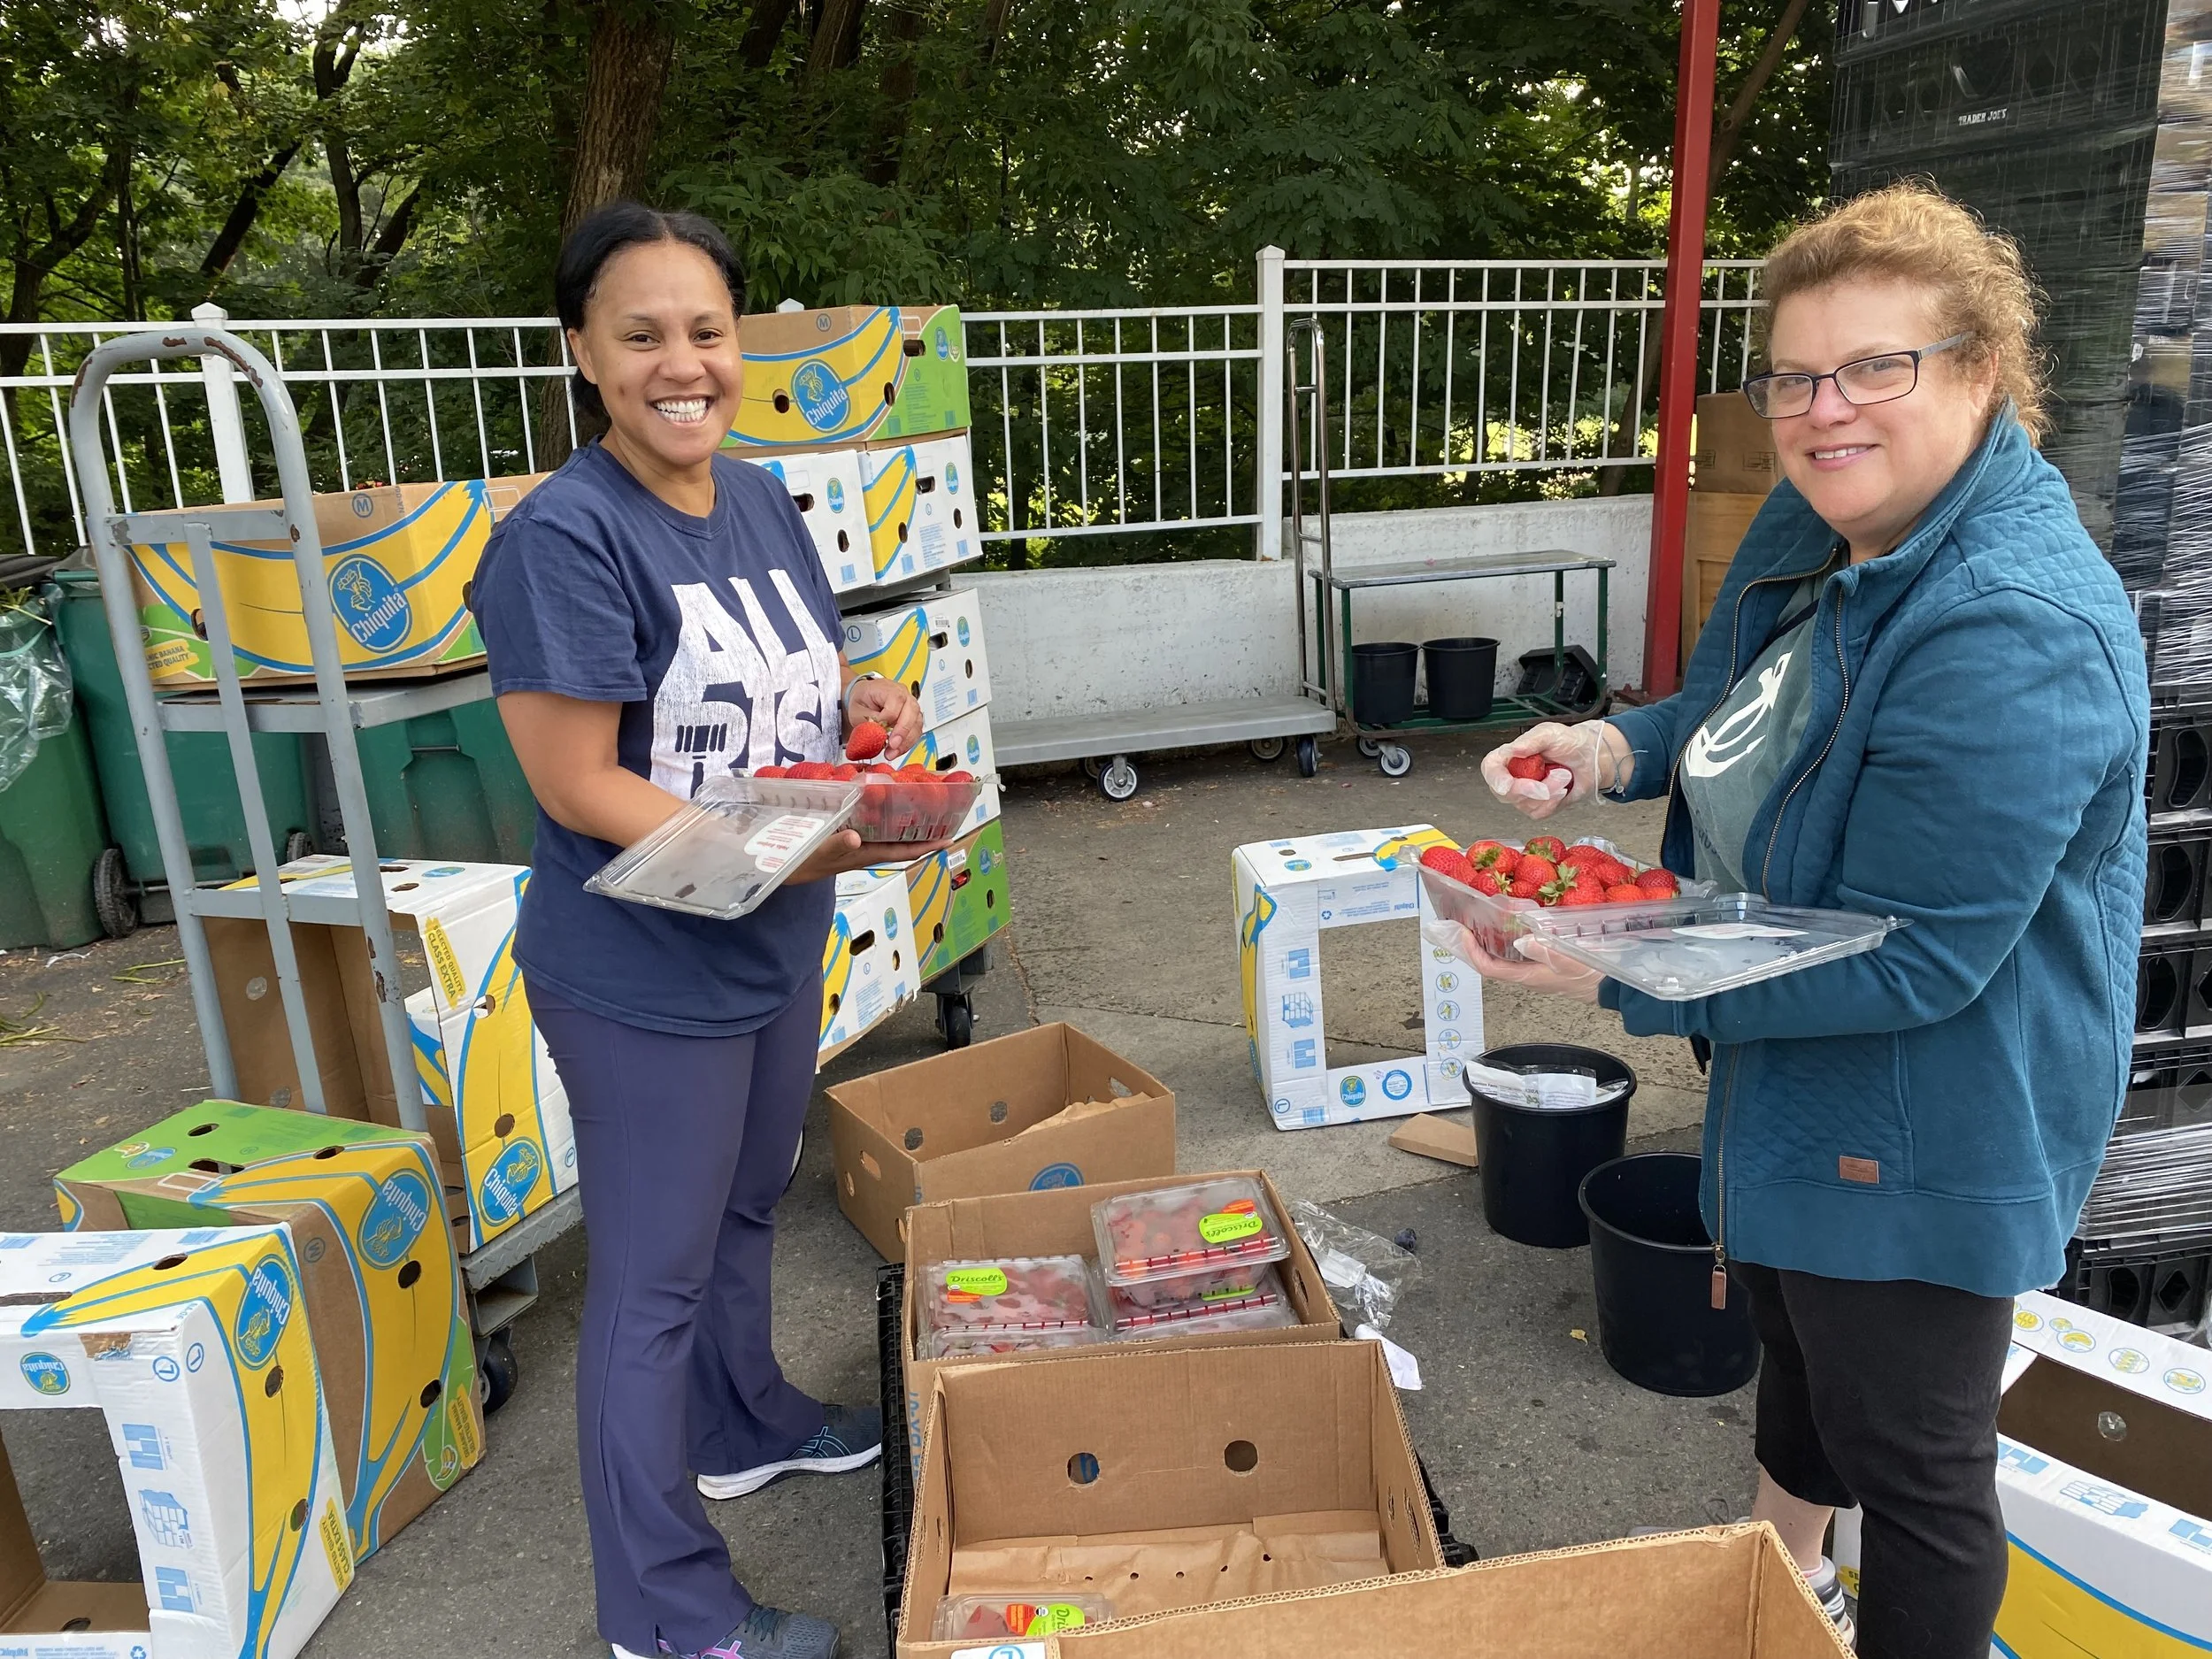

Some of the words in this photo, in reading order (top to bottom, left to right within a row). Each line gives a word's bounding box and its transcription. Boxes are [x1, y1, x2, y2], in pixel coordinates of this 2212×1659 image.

[1958, 112, 1986, 126] TRADER
[806, 388, 848, 426] Chiquita
[351, 591, 407, 643] Chiquita
[655, 569, 841, 700] ALL
[427, 932, 444, 964] CLASS
[440, 964, 457, 999] EXTRA
[434, 925, 451, 961] SELECTED
[448, 961, 464, 992] QUALITY
[381, 1179, 427, 1232] Chiquita
[484, 1168, 518, 1217] Chiquita
[1206, 1220, 1258, 1238] Driscoll's
[252, 1267, 290, 1325] Chiquita
[328, 1509, 342, 1545] EXTRA
[337, 1542, 349, 1574] CLASS
